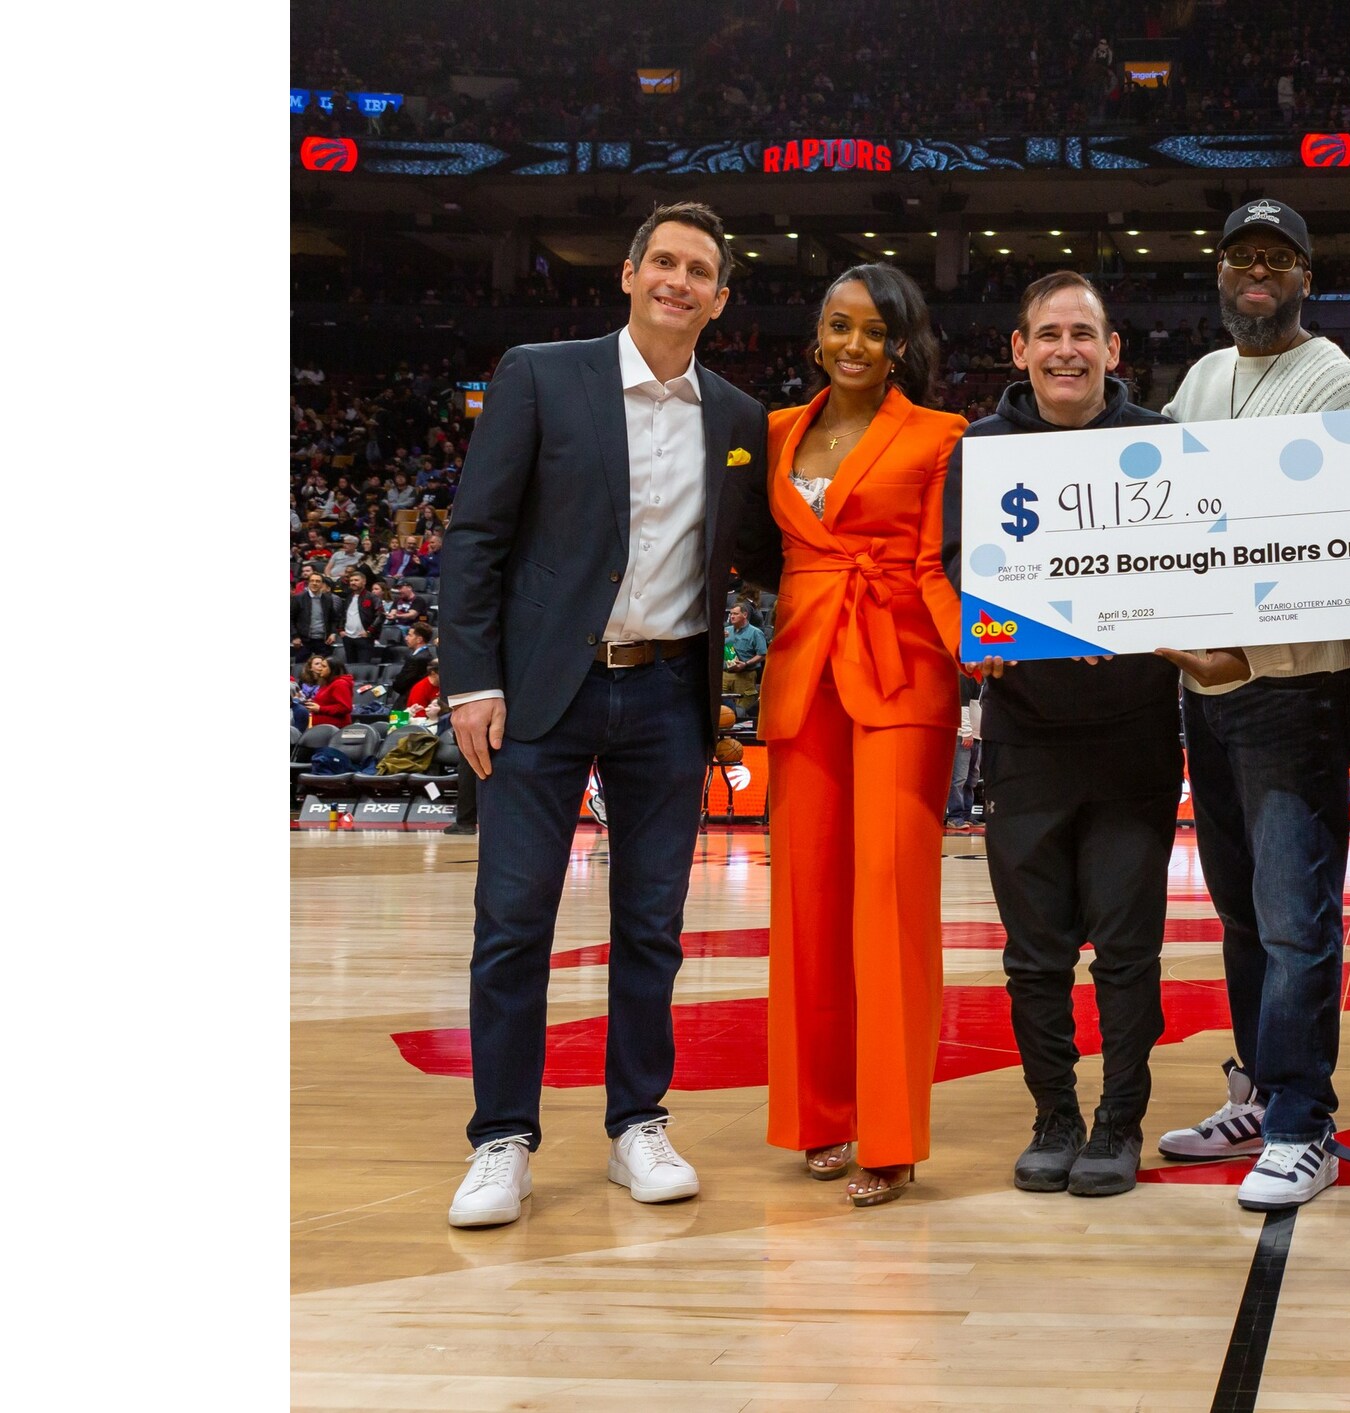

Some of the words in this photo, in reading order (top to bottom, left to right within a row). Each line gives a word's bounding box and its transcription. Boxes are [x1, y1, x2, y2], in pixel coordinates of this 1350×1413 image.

[763, 138, 891, 173] RAPTORS
[1000, 482, 1041, 543] $
[1049, 553, 1110, 578] 2023
[1116, 547, 1227, 575] Borough
[1233, 542, 1321, 566] Ballers
[1014, 565, 1026, 573] TO
[1028, 564, 1043, 572] THE
[998, 573, 1026, 582] ORDER
[1027, 573, 1039, 581] OF
[1258, 602, 1292, 611] ONTARIO
[1293, 599, 1325, 609] LOTTERY
[1326, 598, 1342, 606] AND
[1097, 610, 1120, 622] April
[1121, 609, 1131, 619] 9,
[1131, 608, 1155, 618] 2023
[1258, 613, 1299, 623] SIGNATURE
[971, 621, 1017, 637] OLG
[1096, 624, 1116, 632] DATE
[362, 803, 401, 813] AXE
[416, 804, 456, 814] AXE
